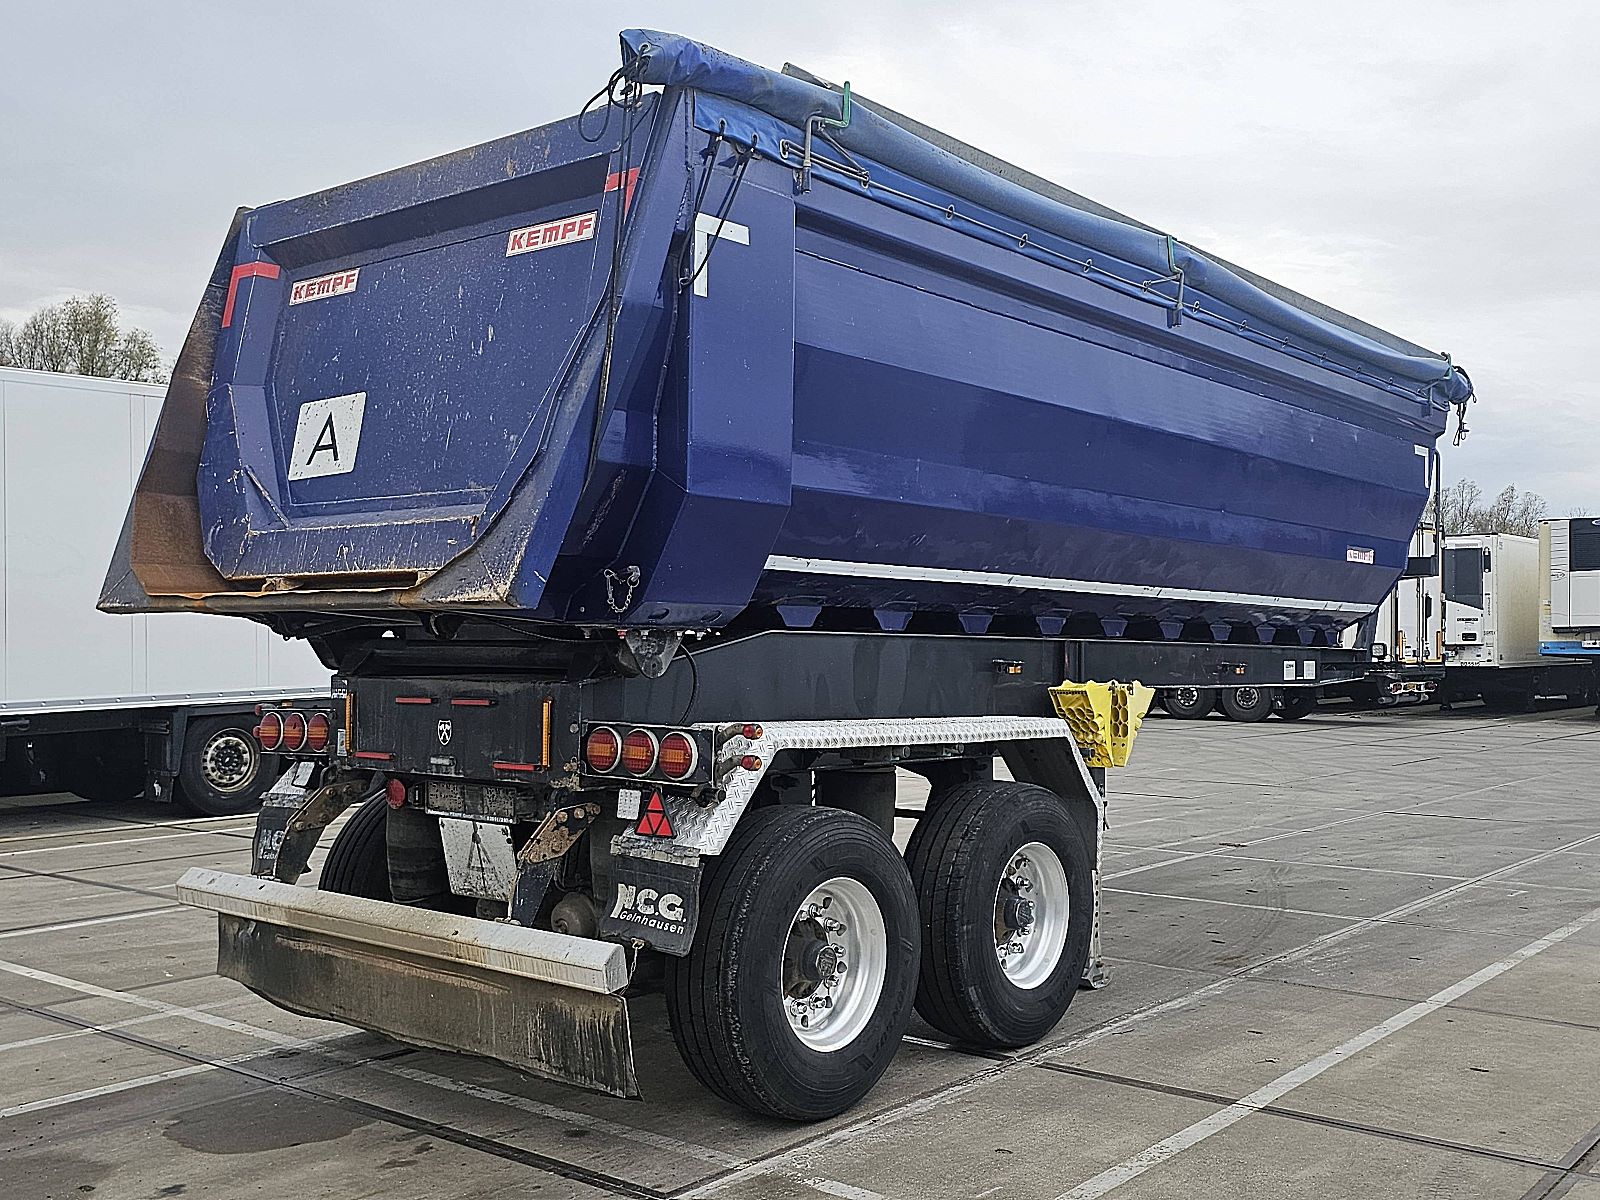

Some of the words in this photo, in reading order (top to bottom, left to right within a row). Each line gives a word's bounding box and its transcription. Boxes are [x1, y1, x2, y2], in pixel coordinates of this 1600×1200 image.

[511, 218, 593, 251] KEMPF
[293, 274, 356, 301] KEMPF
[306, 411, 339, 466] A
[620, 911, 684, 935] Gelnhausen
